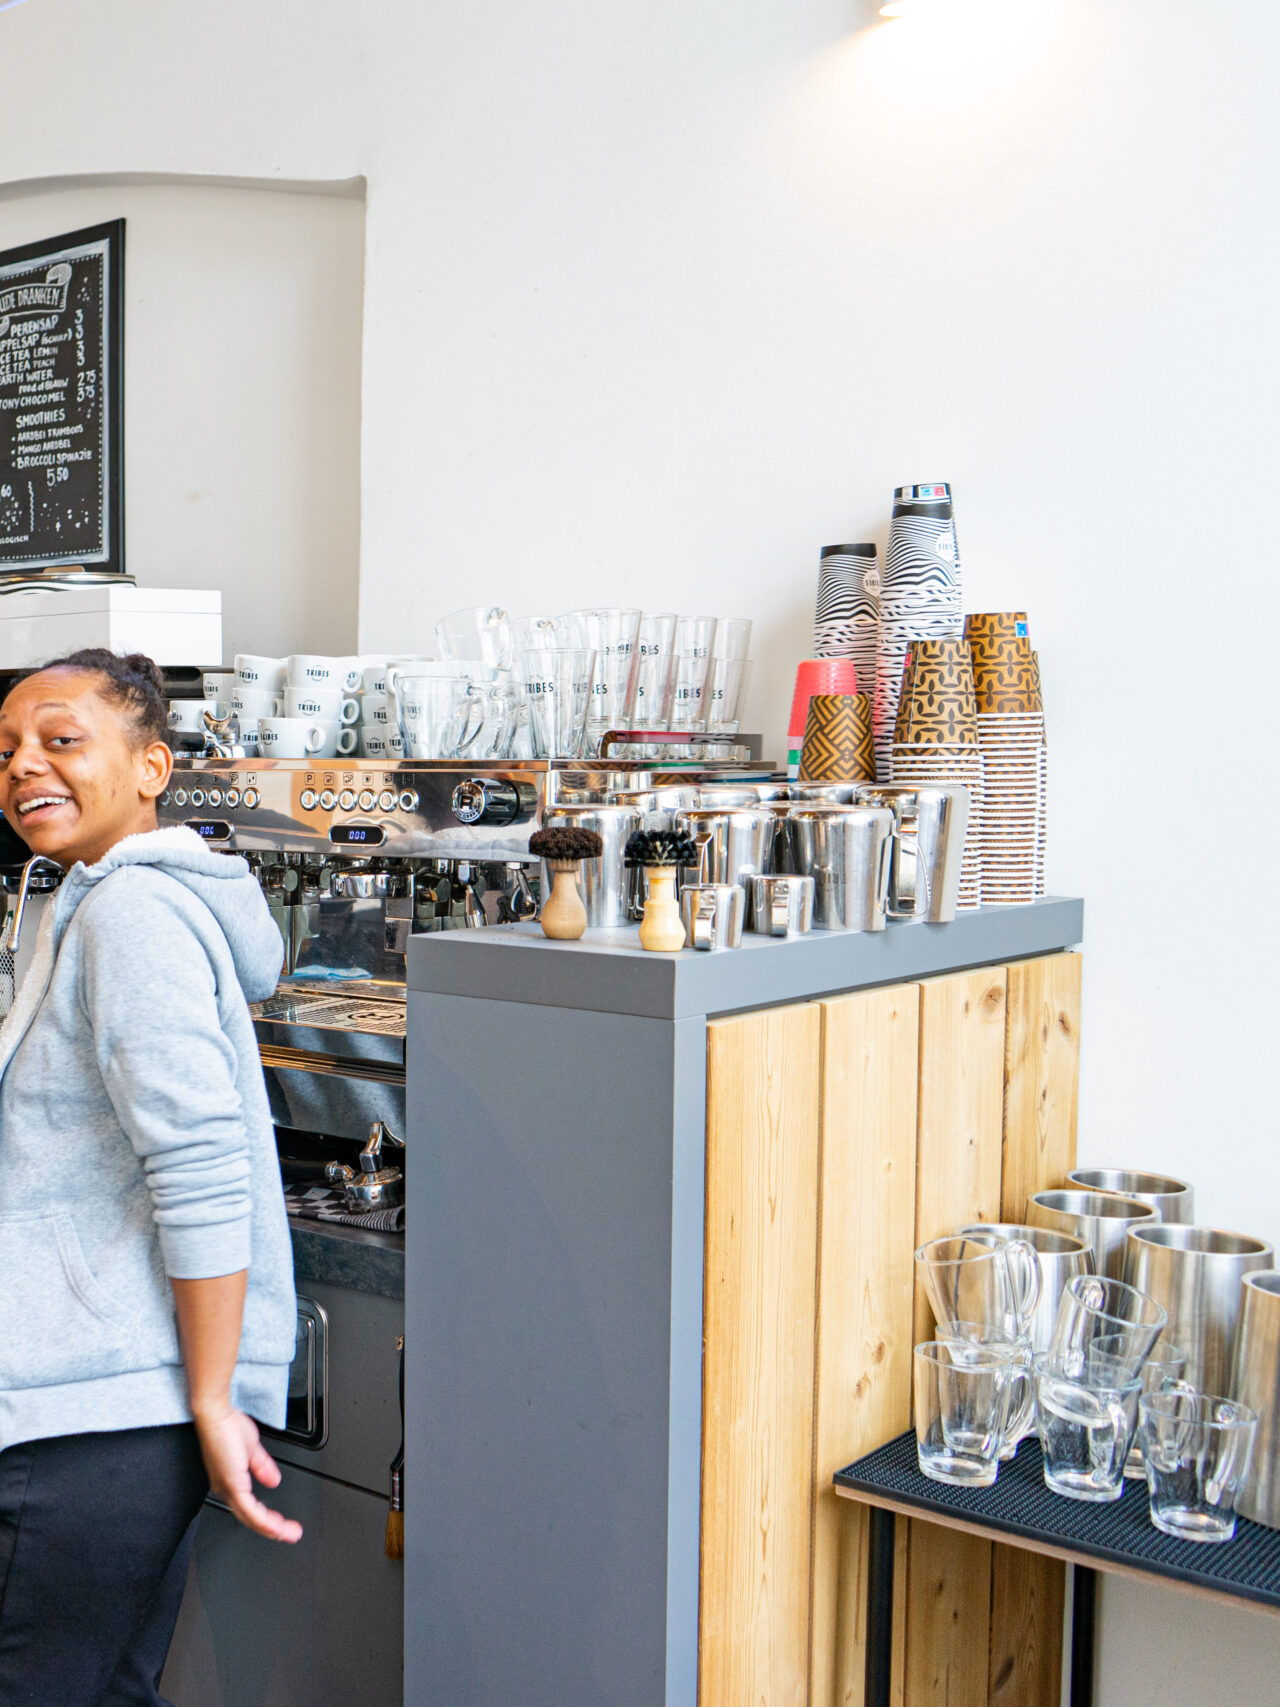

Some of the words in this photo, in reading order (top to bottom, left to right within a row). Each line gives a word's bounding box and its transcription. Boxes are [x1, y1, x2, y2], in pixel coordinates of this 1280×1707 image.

[18, 287, 60, 307] DRANKEN
[10, 314, 59, 338] PERENSAP
[74, 309, 84, 325] 3
[13, 348, 31, 362] TEA
[33, 346, 59, 359] LEMON
[13, 360, 31, 374] TEA
[32, 358, 56, 369] PEACH
[25, 368, 54, 383] WATER
[16, 408, 66, 429] SMOOTHIES
[16, 453, 56, 469] BROCCOLI
[239, 671, 258, 680] TRIBES
[306, 668, 329, 678] TRIBES
[525, 682, 554, 694] TRIBES
[298, 703, 321, 712] TRIBES
[243, 734, 258, 742] TRIB
[389, 738, 402, 747] TRIB
[366, 742, 385, 750] TRIBES
